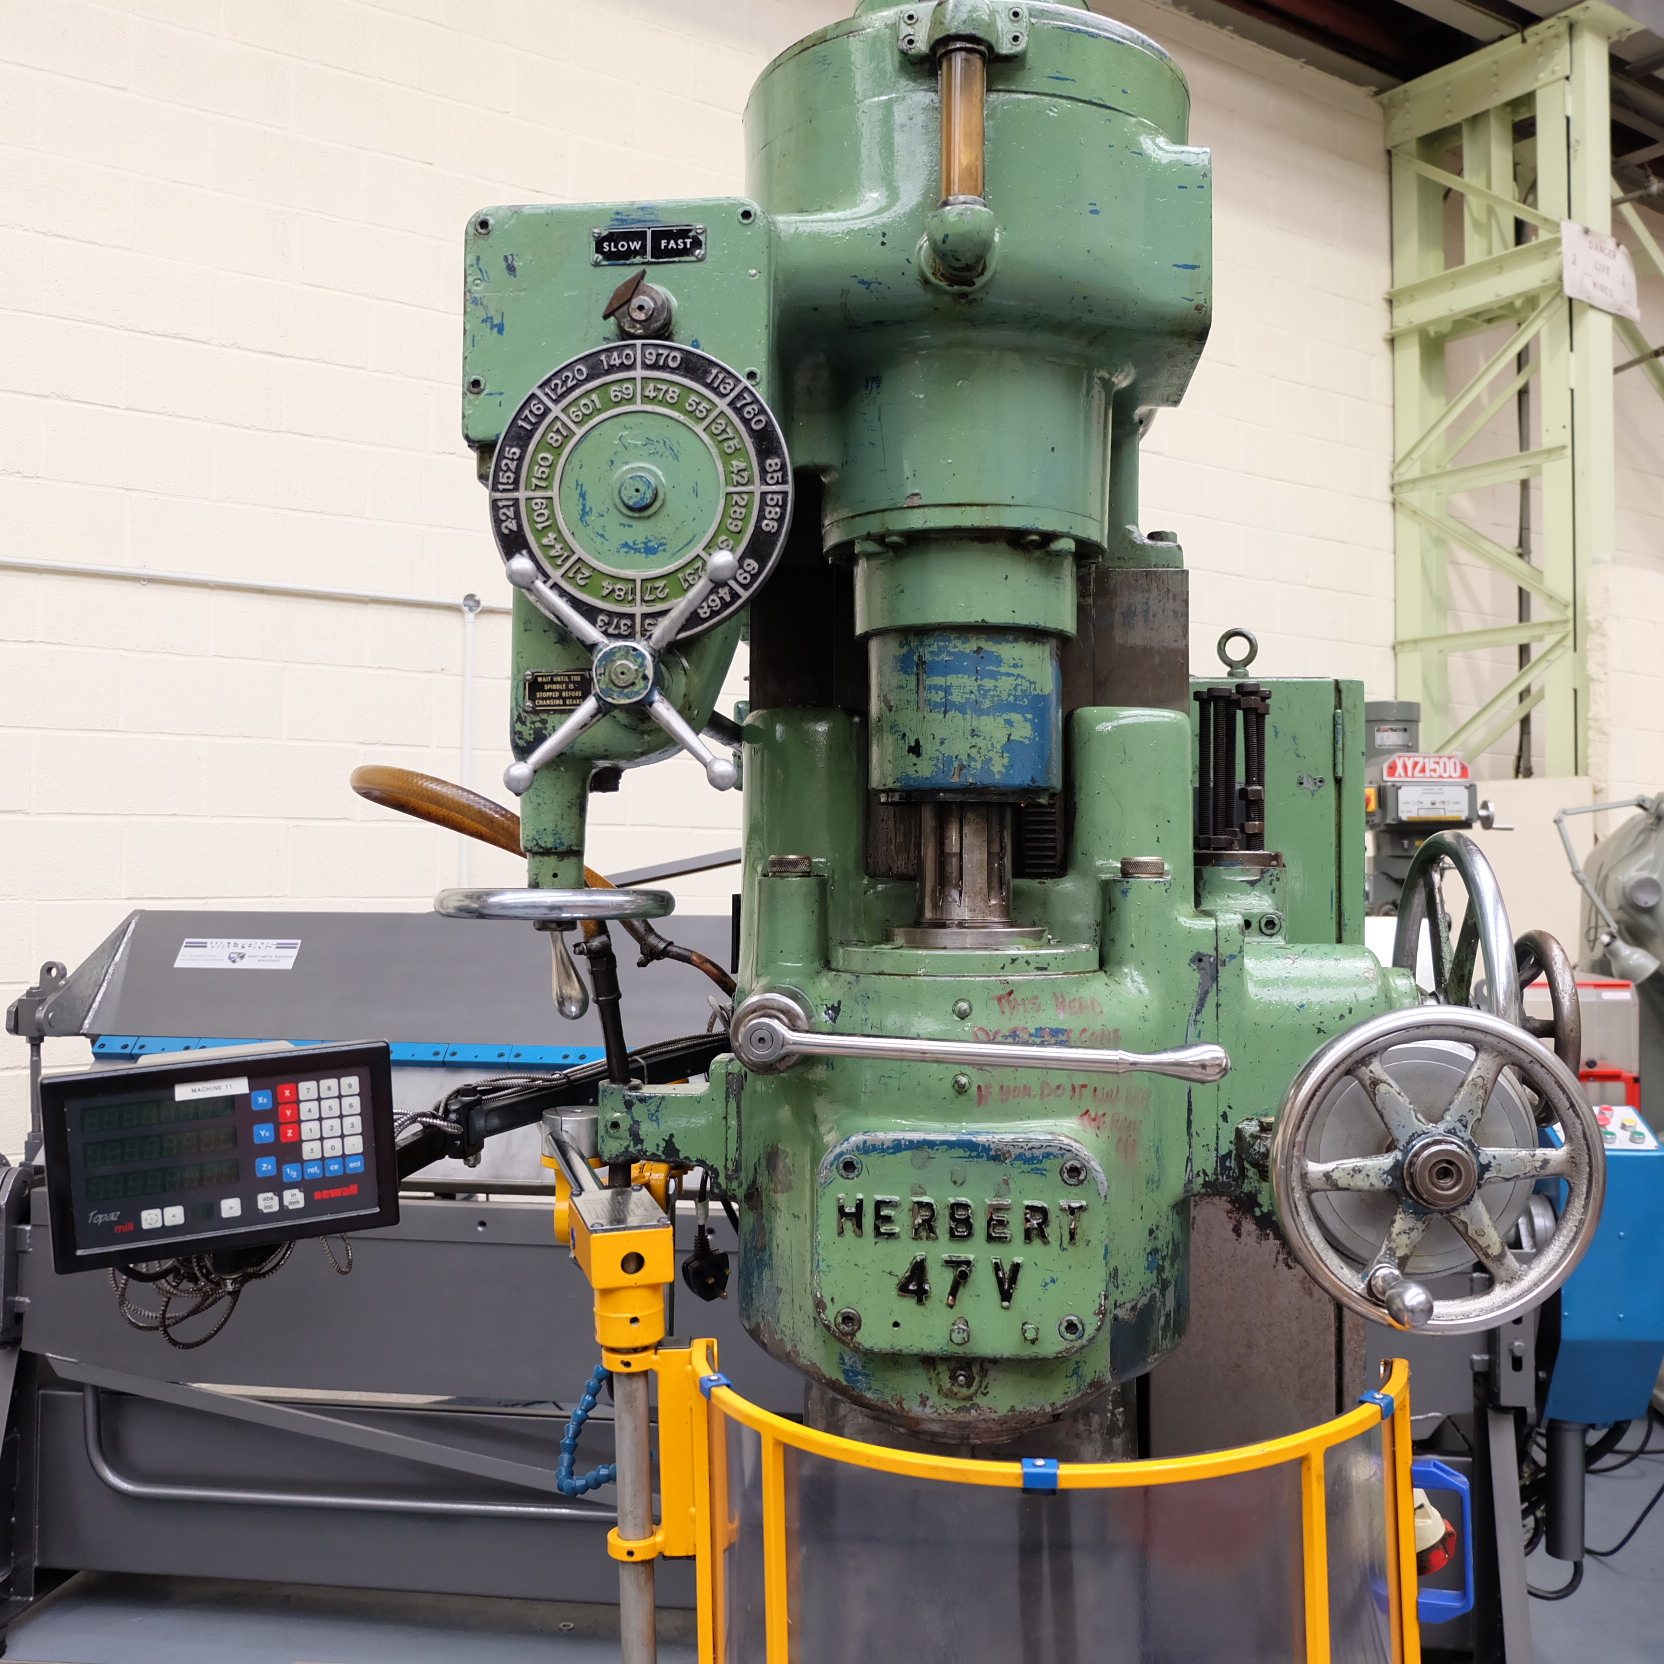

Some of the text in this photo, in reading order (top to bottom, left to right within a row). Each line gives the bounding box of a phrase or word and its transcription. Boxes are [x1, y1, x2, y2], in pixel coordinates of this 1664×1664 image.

[602, 241, 642, 252] SLOW
[661, 239, 693, 250] FAST
[545, 350, 635, 400] 1220 140
[644, 349, 736, 394] 970 113
[569, 383, 634, 422] 601 69
[644, 382, 711, 419] 478 55
[498, 400, 545, 491] 1525 176
[531, 420, 569, 491] 750 87
[711, 420, 750, 486] 375 42
[736, 393, 784, 485] 760 85
[497, 499, 518, 534] 221
[531, 498, 553, 531] 109
[726, 494, 749, 533] 289
[761, 493, 783, 534] 586
[541, 532, 571, 566] 144
[567, 565, 592, 586] 21
[600, 579, 636, 602] 184
[643, 580, 670, 601] 27
[697, 586, 731, 619] 468
[1395, 756, 1460, 778] XYZ1500
[191, 1086, 222, 1094] MACHINE
[284, 1089, 291, 1097] X
[285, 1109, 292, 1117] Y
[287, 1129, 293, 1137] Z
[349, 1160, 361, 1168] ent
[88, 1209, 121, 1226] Topaz
[836, 1193, 1088, 1246] HERBERT
